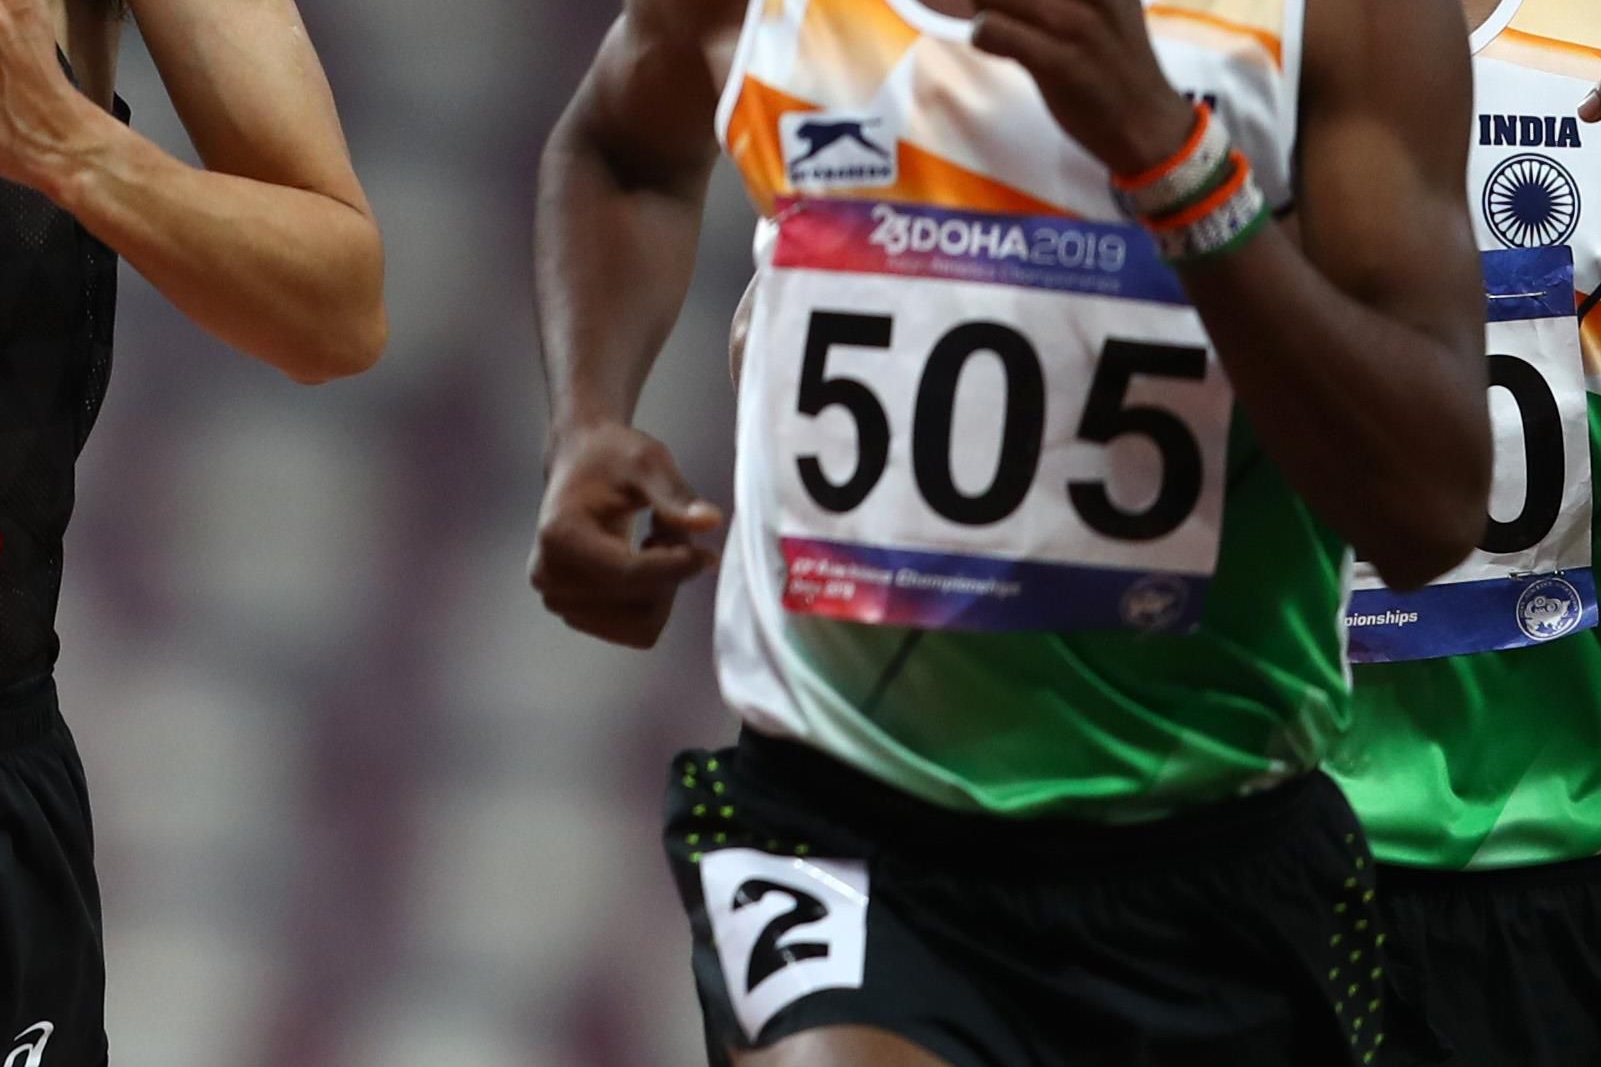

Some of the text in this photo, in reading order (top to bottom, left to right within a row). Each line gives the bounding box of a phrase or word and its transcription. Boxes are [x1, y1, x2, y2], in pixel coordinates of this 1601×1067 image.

[1478, 114, 1581, 148] INDIA
[796, 310, 1207, 542] 505
[732, 878, 830, 996] 2
